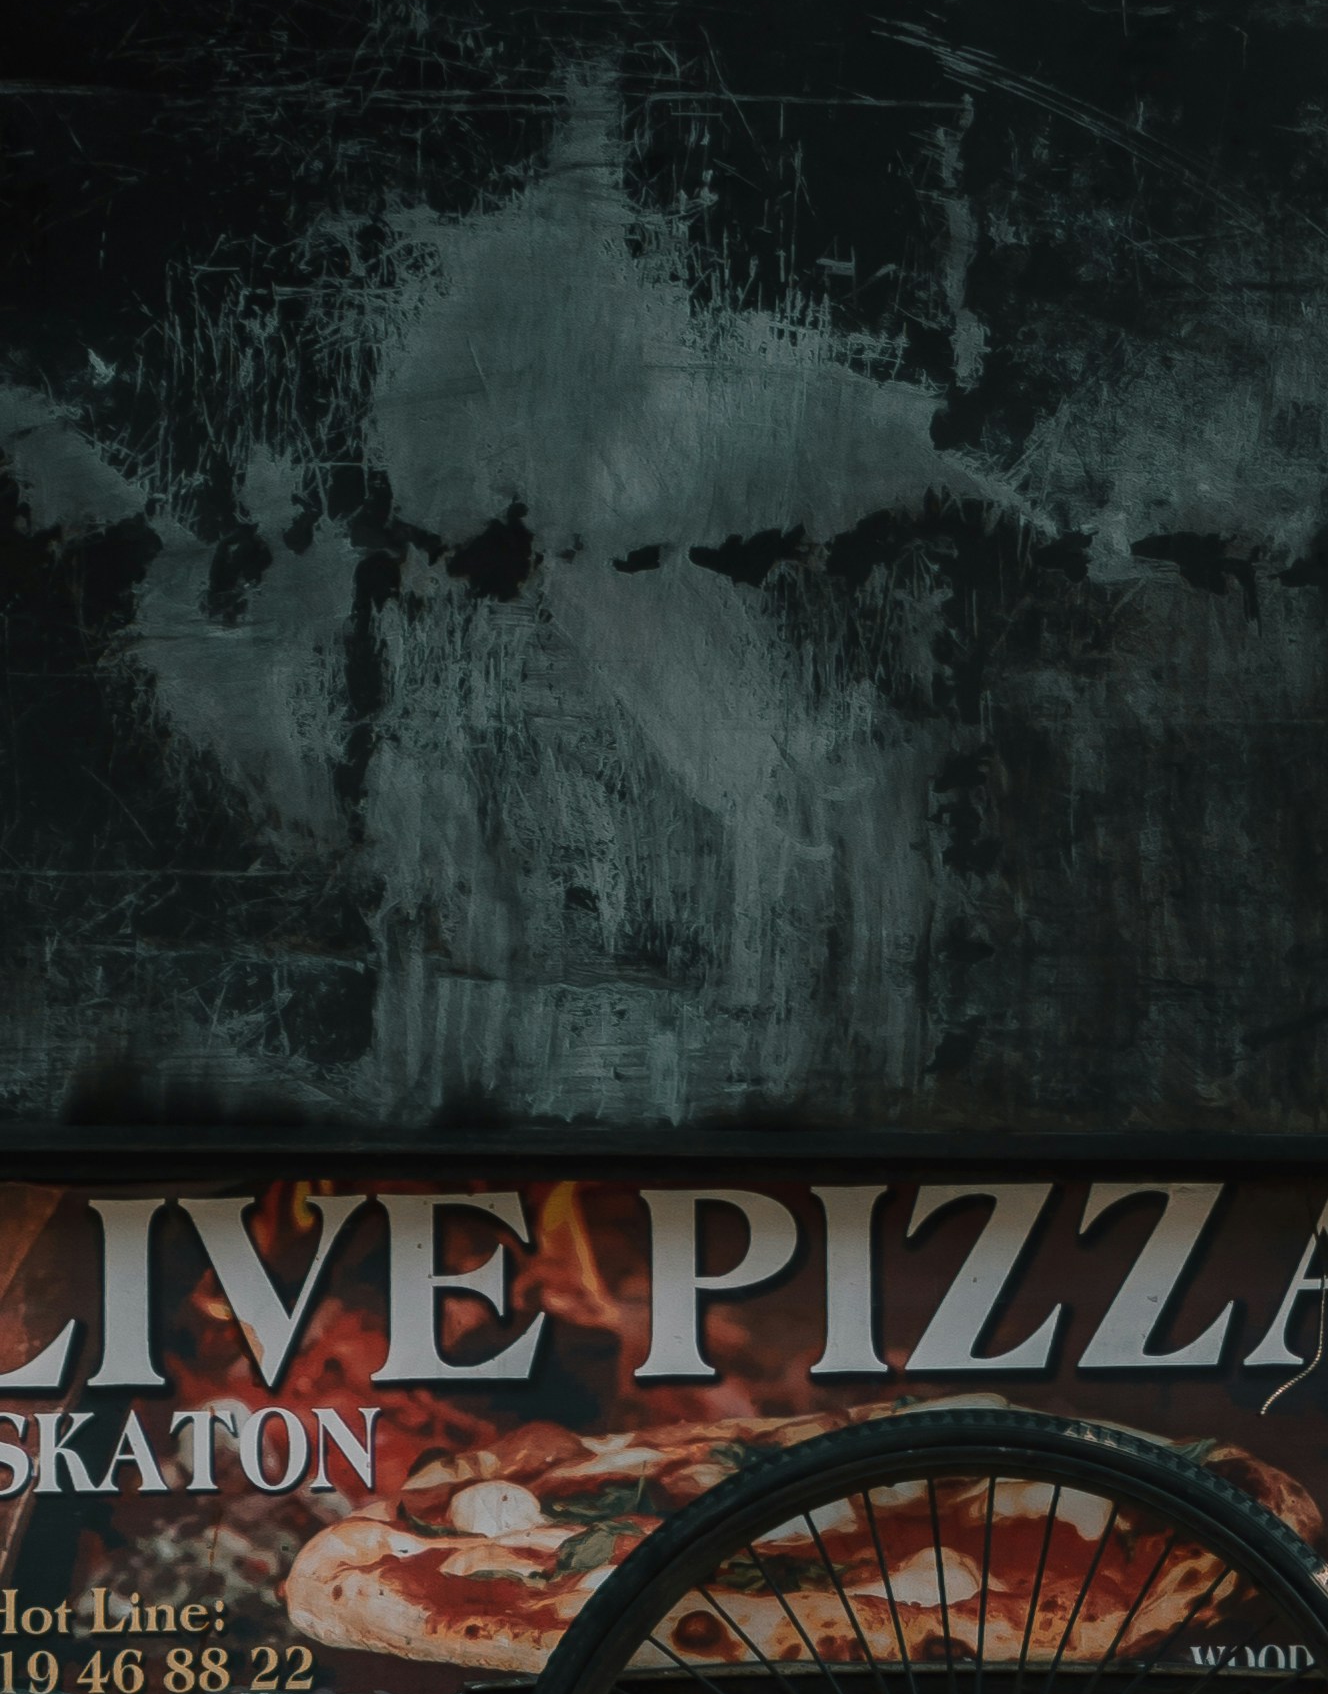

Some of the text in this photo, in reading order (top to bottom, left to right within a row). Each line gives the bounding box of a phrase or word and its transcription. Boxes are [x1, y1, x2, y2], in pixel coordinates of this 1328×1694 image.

[0, 1406, 381, 1495] SKATON
[90, 1587, 225, 1634] Line:
[76, 1649, 145, 1694] 46
[163, 1647, 230, 1694] 88
[250, 1646, 314, 1692] 22
